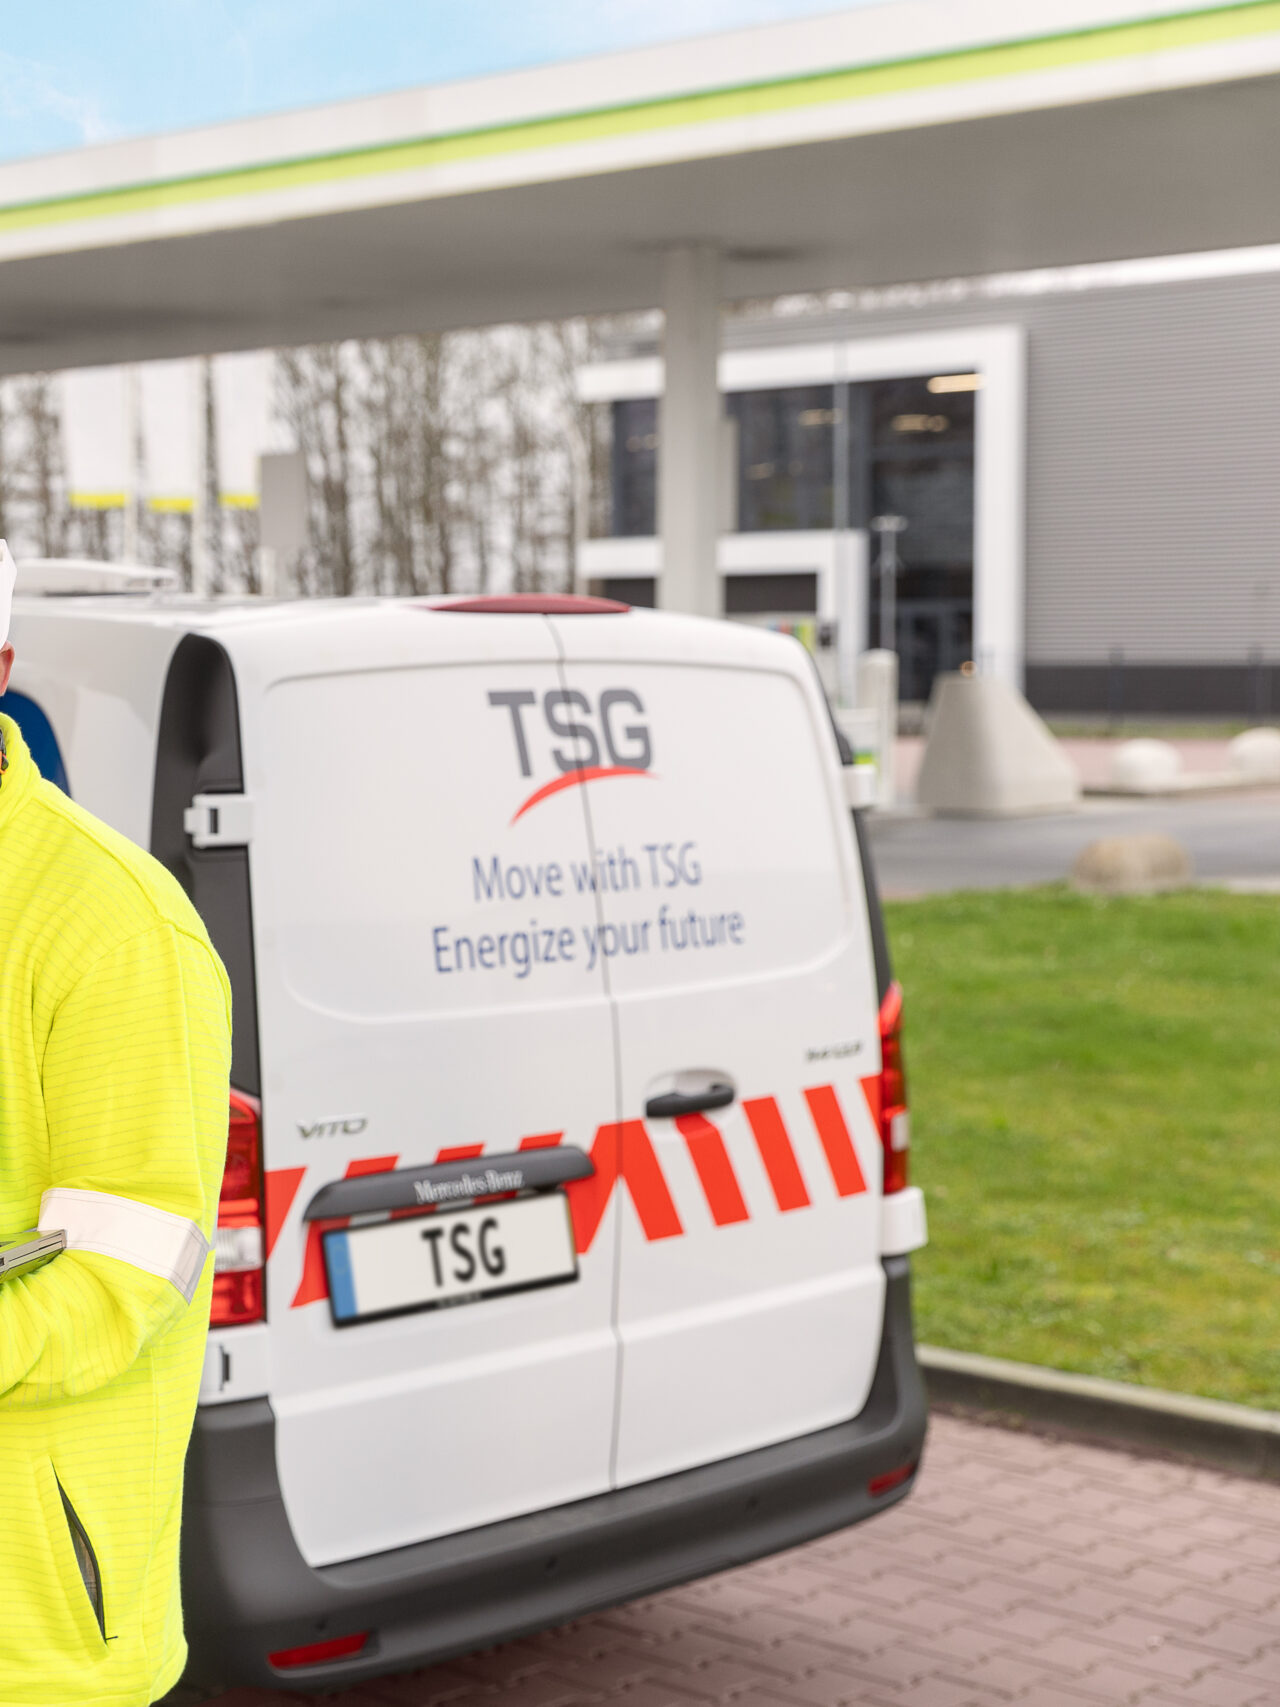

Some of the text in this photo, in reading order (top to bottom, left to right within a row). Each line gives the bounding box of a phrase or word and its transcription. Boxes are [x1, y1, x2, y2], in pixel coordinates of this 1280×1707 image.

[487, 689, 652, 777] TSG
[472, 841, 703, 901] Move with TSG
[432, 905, 745, 979] Energize your future
[296, 1117, 368, 1139] VITO
[421, 1217, 506, 1287] TSG
